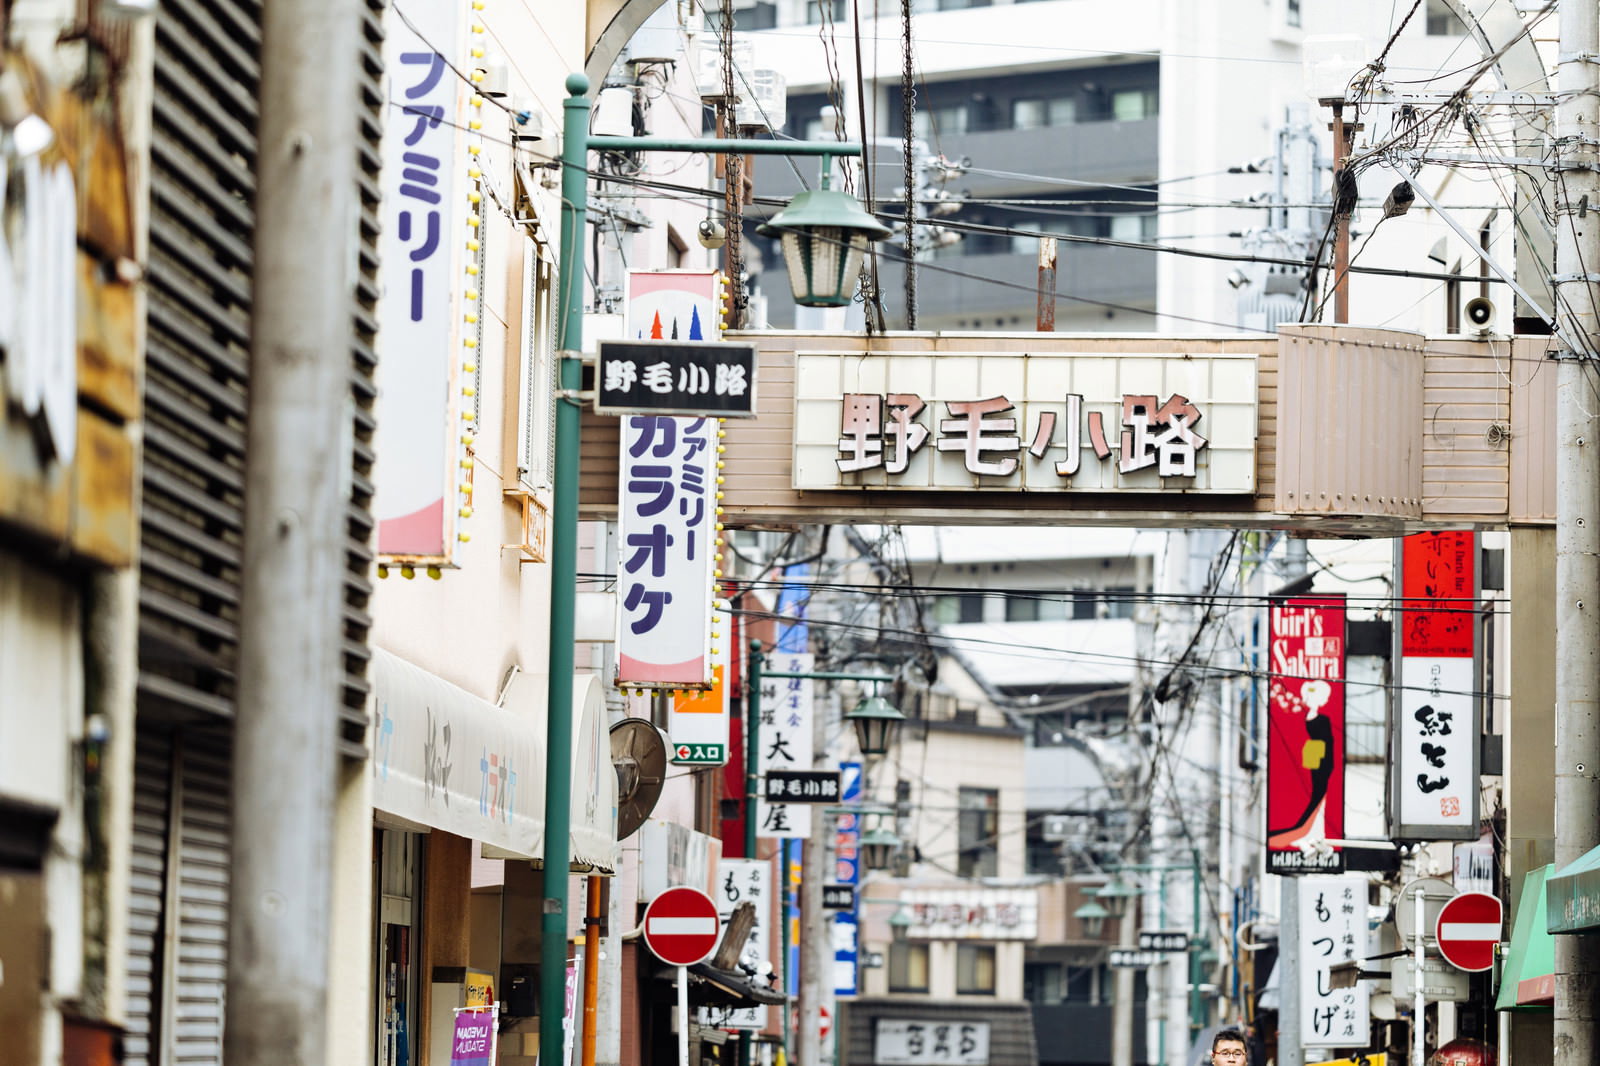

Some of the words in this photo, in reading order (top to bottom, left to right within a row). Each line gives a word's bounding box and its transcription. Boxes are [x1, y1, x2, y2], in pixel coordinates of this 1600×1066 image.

[399, 52, 446, 322] ファミリー
[604, 360, 748, 396] 野毛小路
[835, 393, 1208, 477] 野毛小路
[624, 416, 677, 635] カラオケ
[1273, 639, 1339, 679] Sakura
[480, 744, 517, 825] カラオケ
[694, 746, 719, 759] 入口
[762, 732, 796, 832] 大屋
[769, 779, 838, 796] 野毛小路
[1312, 892, 1340, 1037] もつしげ
